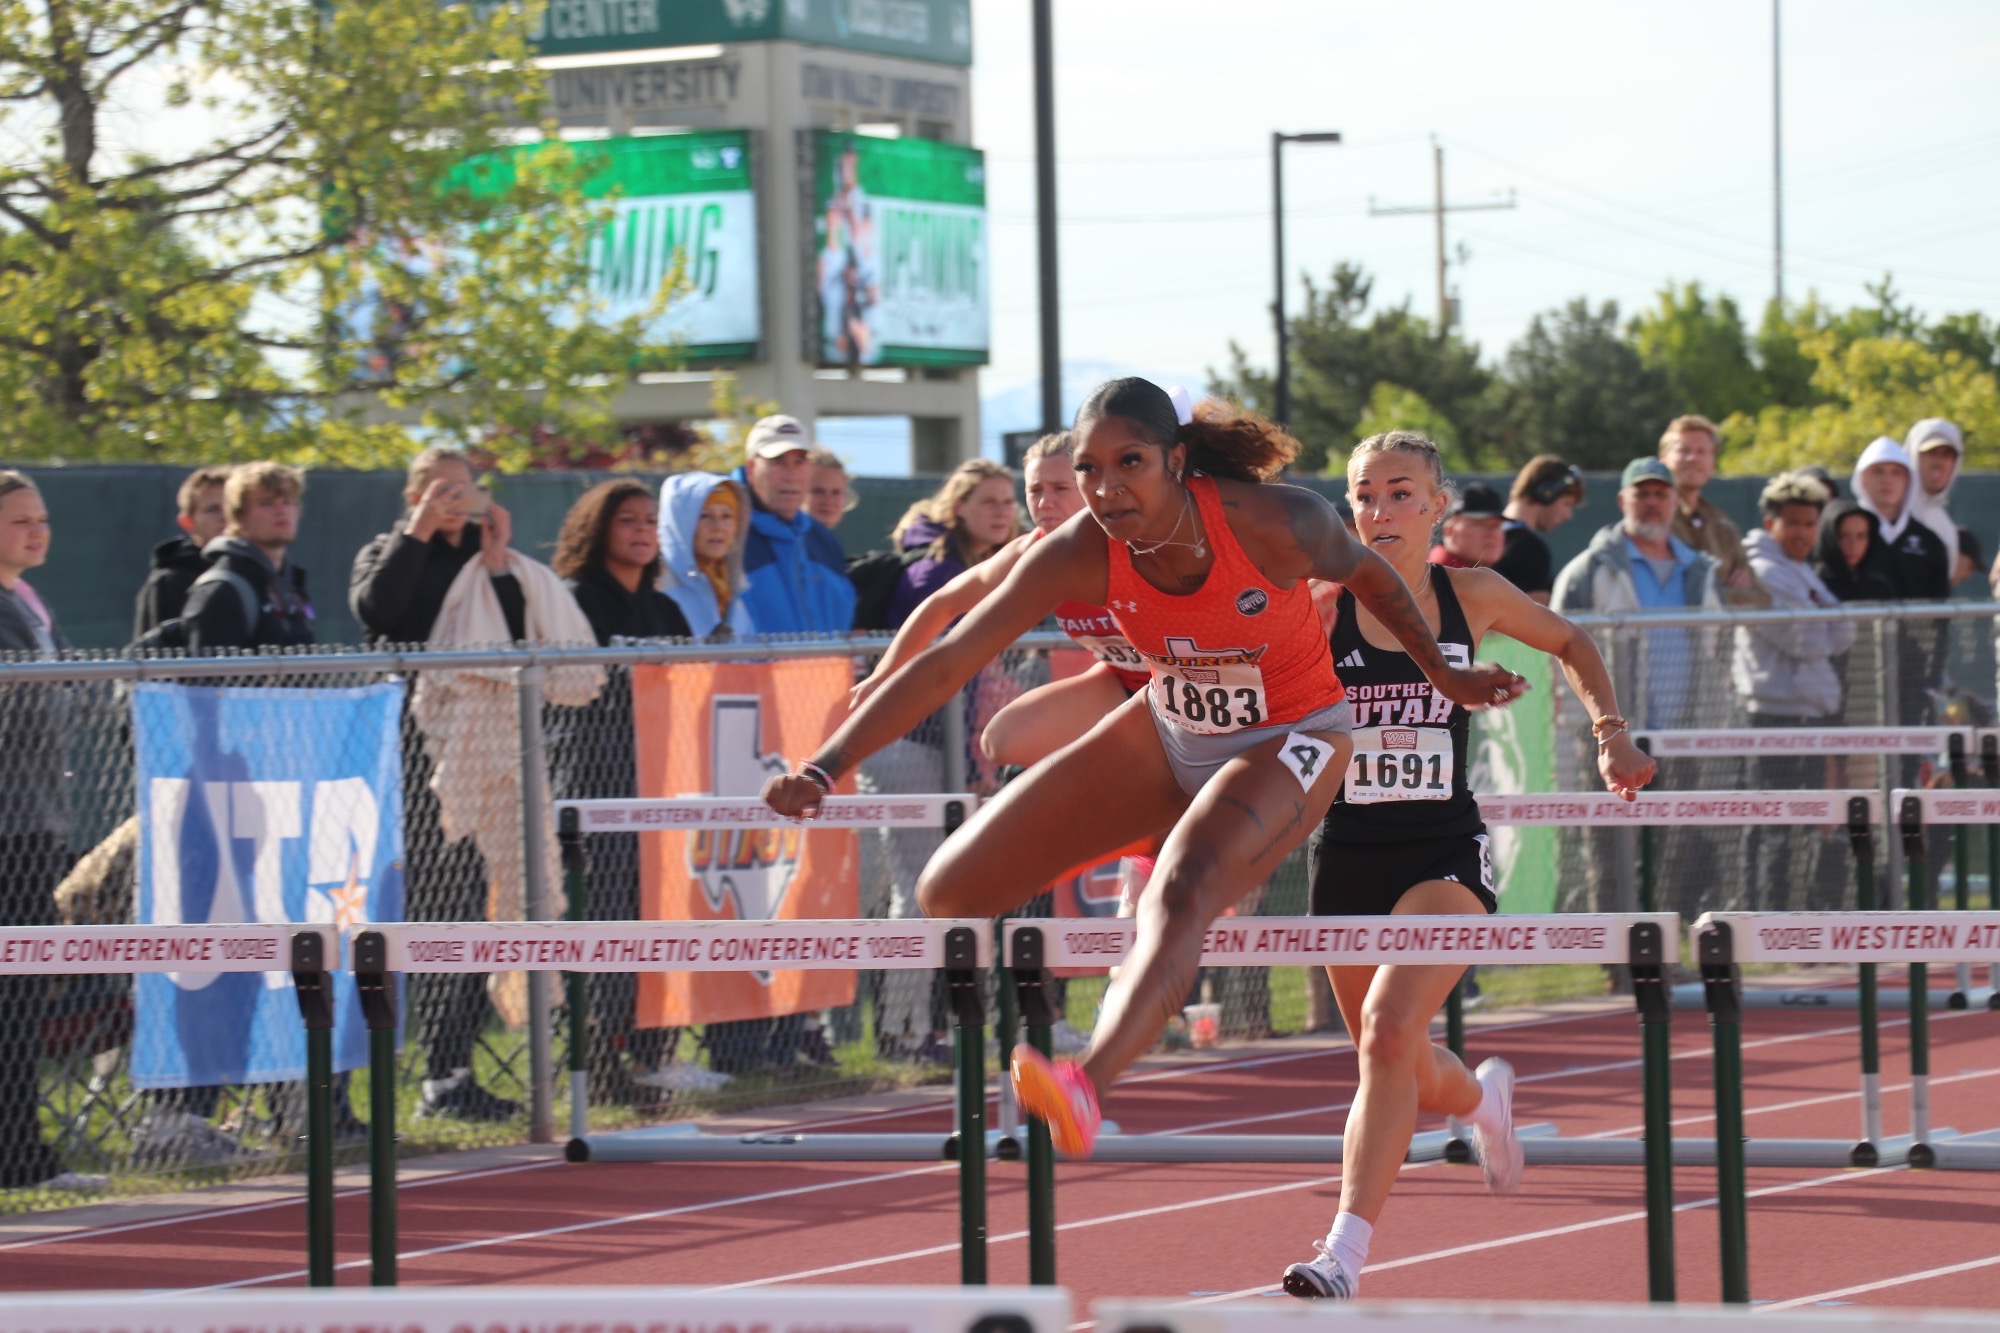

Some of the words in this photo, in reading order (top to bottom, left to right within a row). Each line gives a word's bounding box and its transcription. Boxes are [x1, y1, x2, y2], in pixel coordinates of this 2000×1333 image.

[594, 203, 721, 303] MING
[1056, 617, 1096, 631] TAH
[1162, 675, 1261, 728] 1883
[1345, 682, 1431, 701] SOUTHE
[1349, 697, 1455, 729] UTAH
[1383, 731, 1416, 744] WAC
[1289, 745, 1321, 779] 4
[1353, 753, 1445, 789] 1691
[630, 808, 703, 823] WESTERN
[1510, 803, 1589, 820] WESTERN
[1594, 802, 1671, 818] ATHLETIC
[1675, 801, 1783, 818] CONFERENCE
[0, 939, 55, 962] ETIC
[63, 937, 215, 962] CONFERENCE
[471, 939, 586, 963] WESTERN
[590, 938, 702, 963] ATHLETIC
[708, 936, 862, 962] CONFERENCE
[1253, 928, 1370, 952] ATHLETIC
[1377, 926, 1540, 951] CONFERENCE
[1830, 925, 1958, 950] WESTERN
